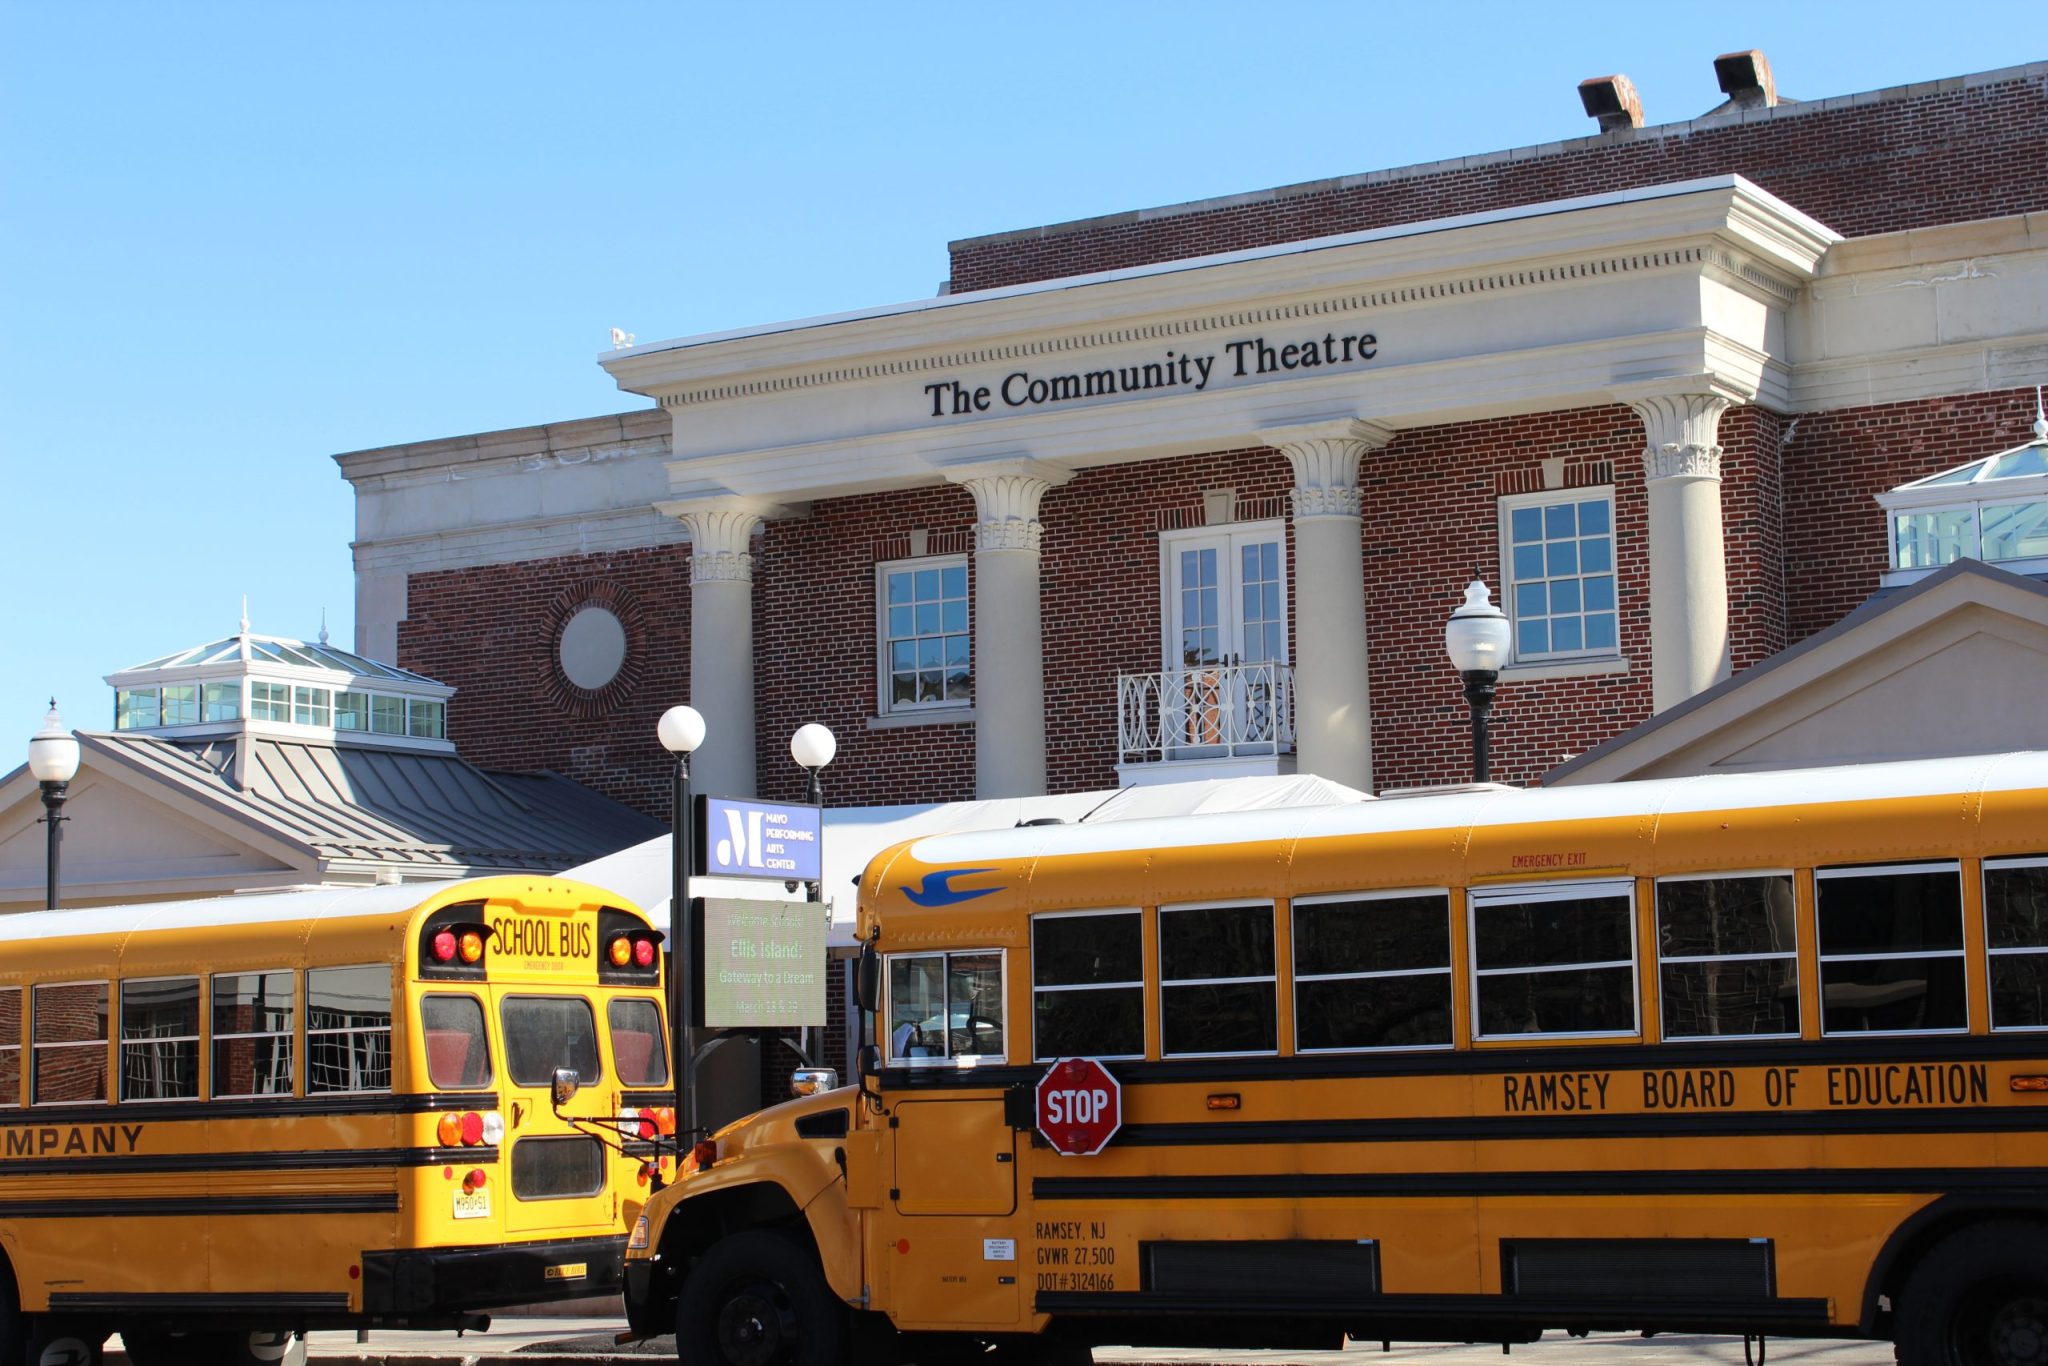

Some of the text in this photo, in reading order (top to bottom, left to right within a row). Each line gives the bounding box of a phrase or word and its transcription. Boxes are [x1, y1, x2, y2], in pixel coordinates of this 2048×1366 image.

[925, 332, 1378, 416] The Community Theatre
[766, 813, 788, 824] MAYO
[766, 828, 814, 841] PERFORMING
[766, 843, 784, 854] ARTS
[766, 859, 796, 869] CENTER
[1512, 852, 1587, 868] EMERGENCY EXIT
[493, 918, 590, 958] SCHOOL BUS
[731, 939, 802, 959] Ellis Island:
[720, 970, 814, 987] Gateway to a Dream
[1503, 1064, 1988, 1112] RAMSEY BOARD OF EDUCATION
[1047, 1089, 1108, 1124] STOP
[0, 1125, 143, 1155] MPANY
[1036, 1222, 1106, 1241] RAMSEY, NJ
[1037, 1247, 1069, 1265] GVWR
